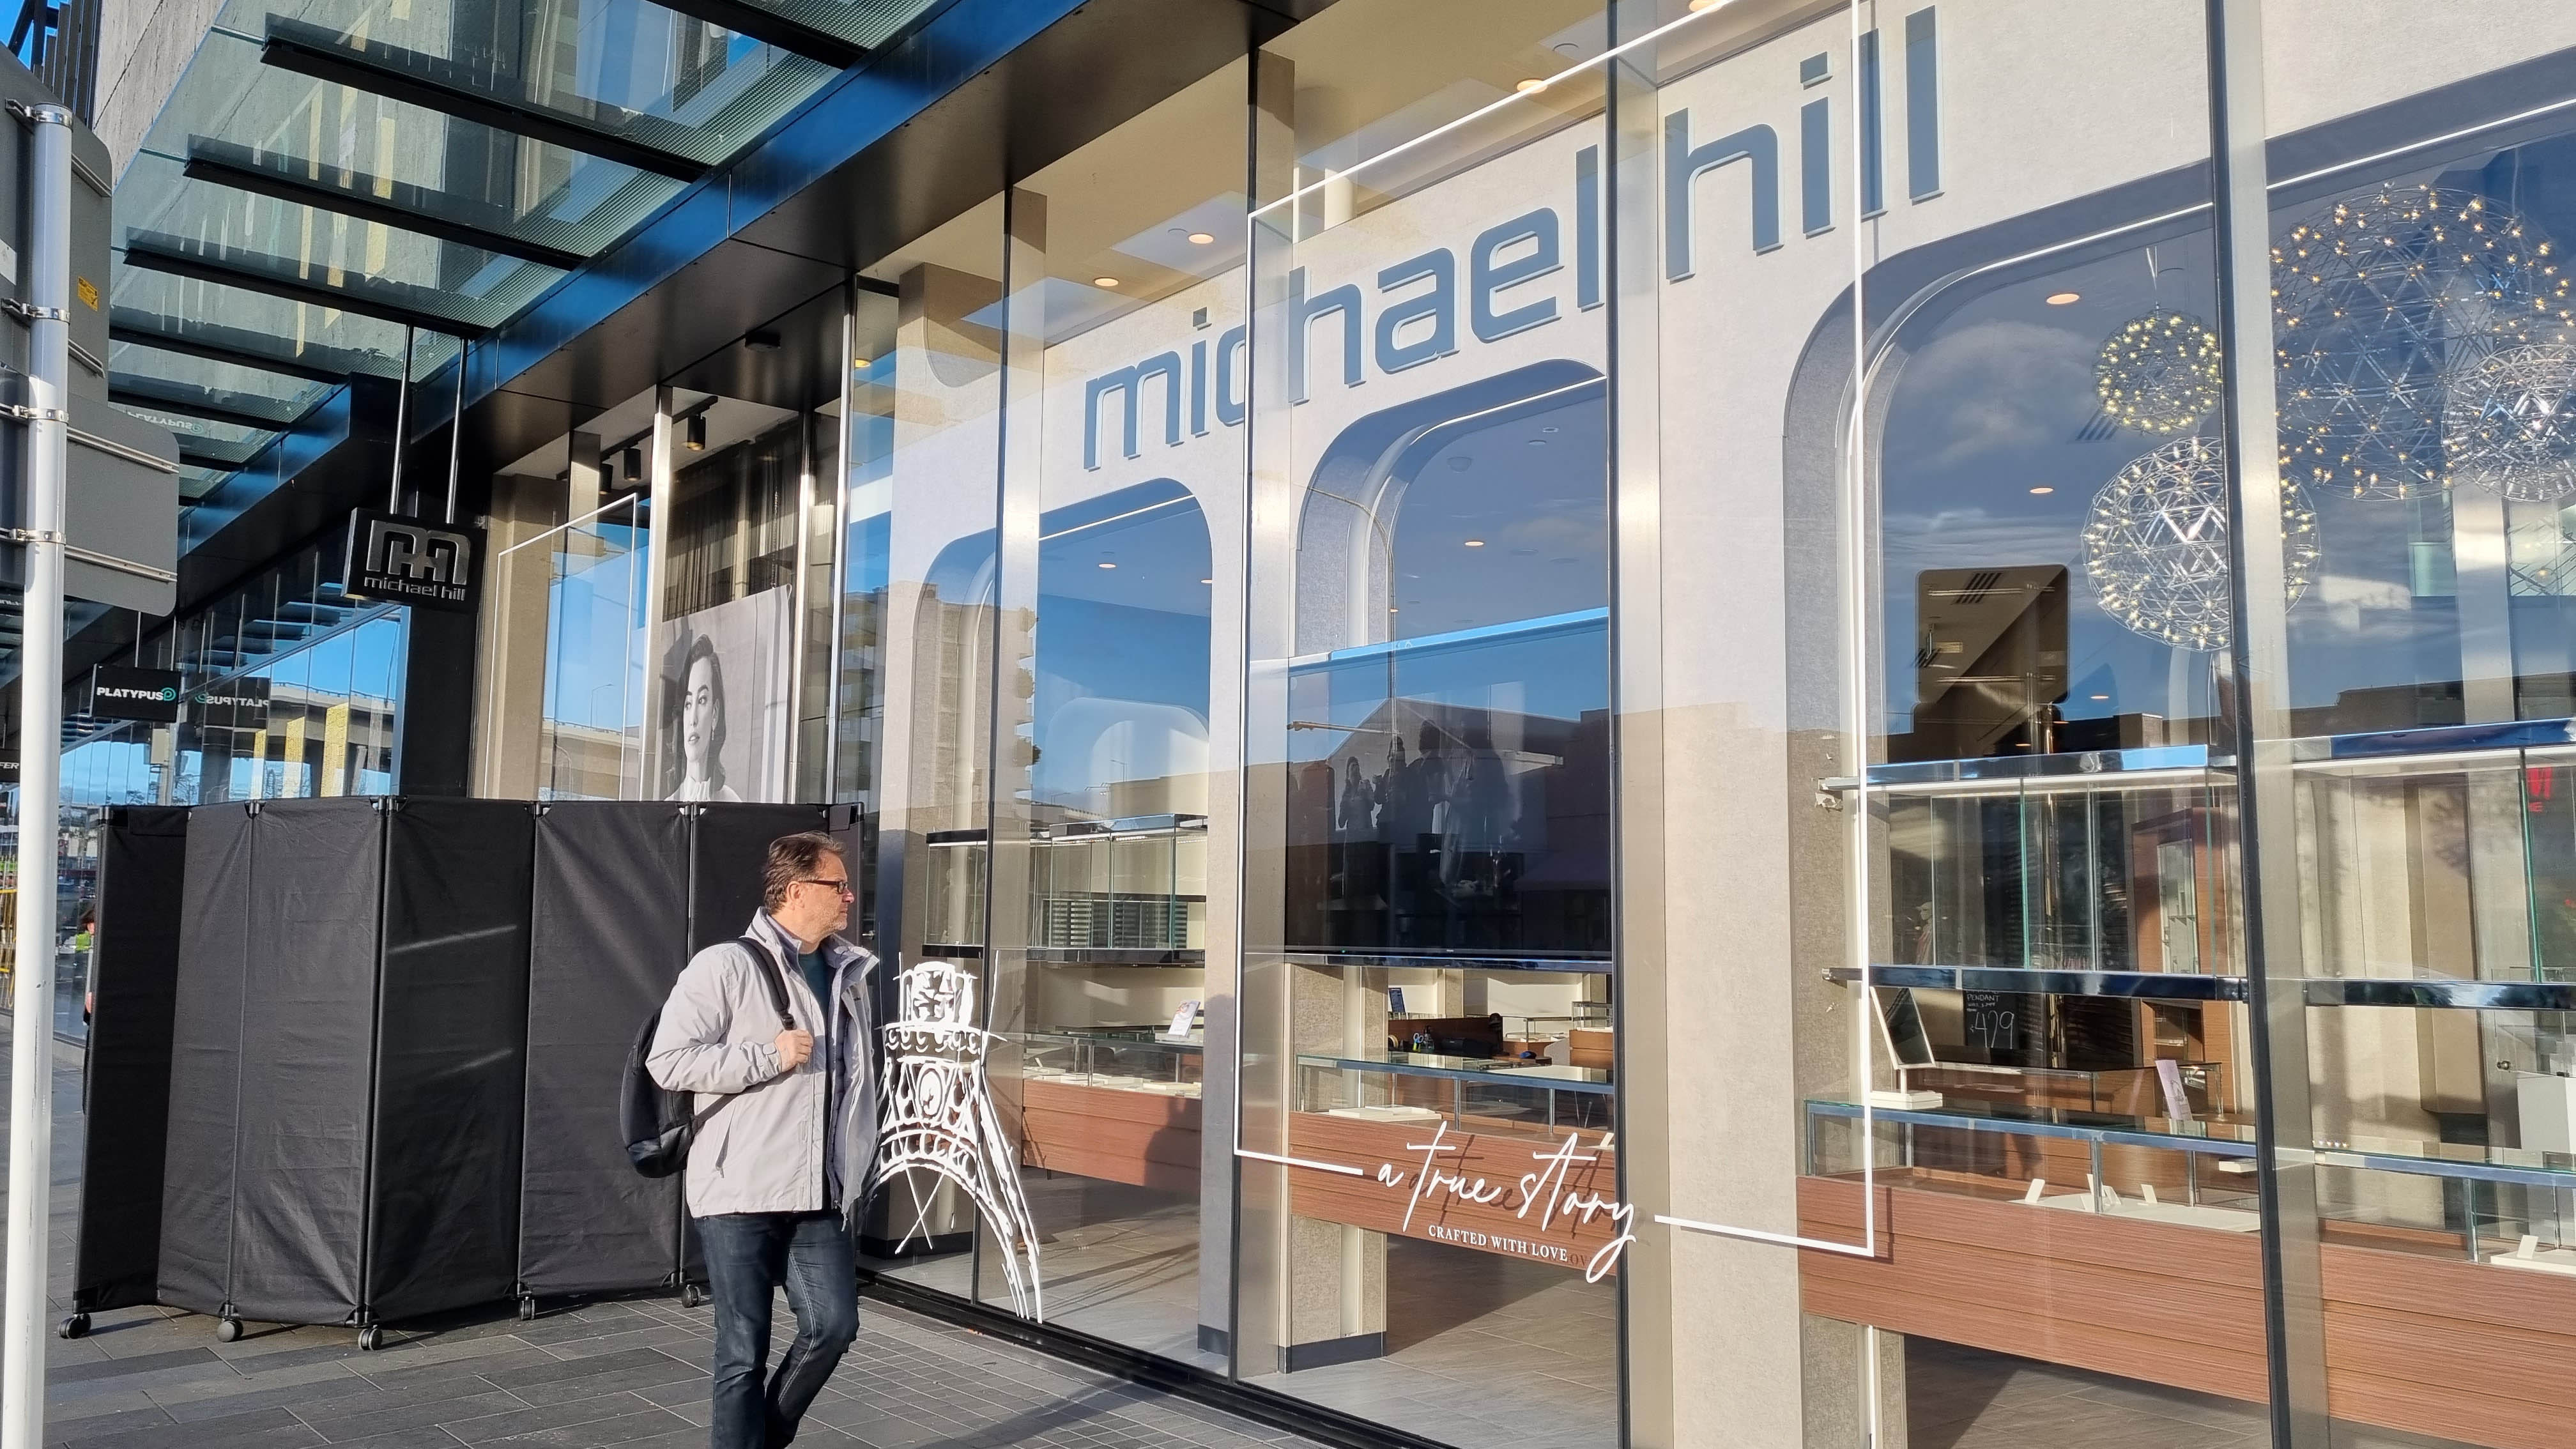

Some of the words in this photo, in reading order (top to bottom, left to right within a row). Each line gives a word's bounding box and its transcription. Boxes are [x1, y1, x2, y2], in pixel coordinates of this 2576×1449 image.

[1084, 144, 1605, 472] michael
[1664, 6, 1945, 282] hill
[364, 576, 438, 597] michael
[441, 586, 466, 601] hill
[96, 687, 164, 702] PLATYPUS
[1377, 1161, 1406, 1188] a
[1402, 1121, 1502, 1232] true
[1517, 1132, 1637, 1284] story
[1428, 1225, 1487, 1246] CRAFTED
[1491, 1235, 1527, 1254] WITH
[1531, 1243, 1568, 1262] LOVE
